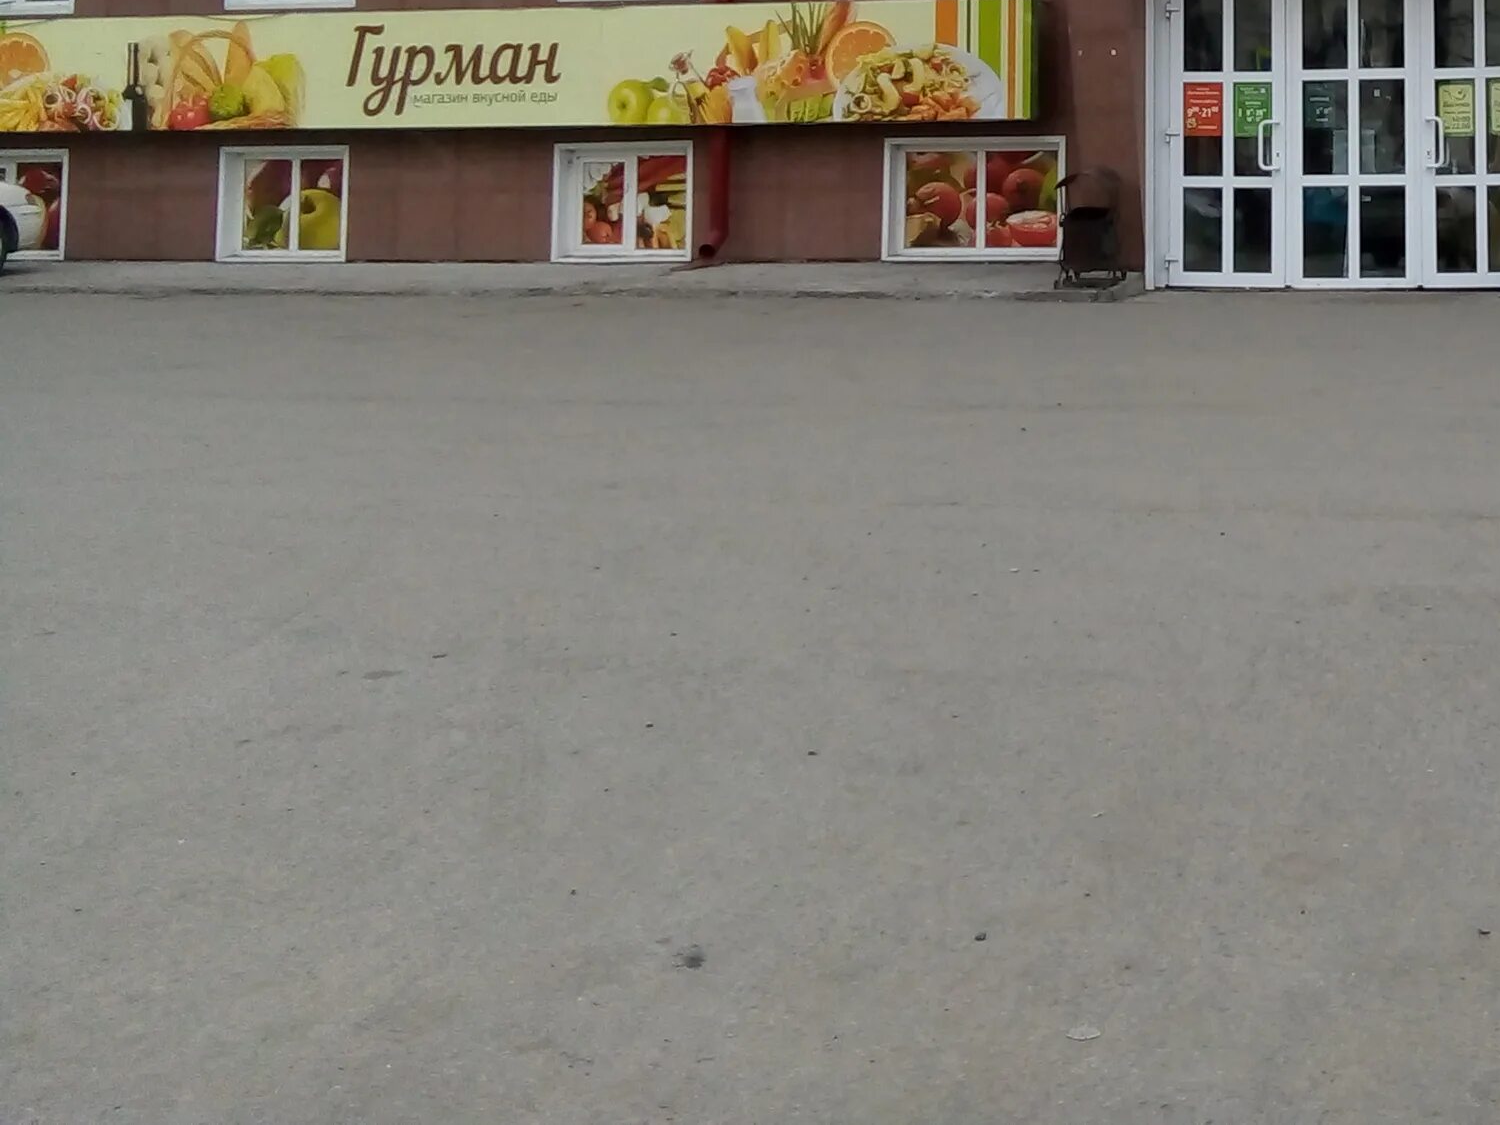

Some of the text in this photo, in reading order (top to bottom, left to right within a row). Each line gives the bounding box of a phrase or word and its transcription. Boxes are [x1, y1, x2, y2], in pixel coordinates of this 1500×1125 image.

[346, 23, 562, 117] Гурман
[413, 90, 558, 107] магазин вкусной еды
